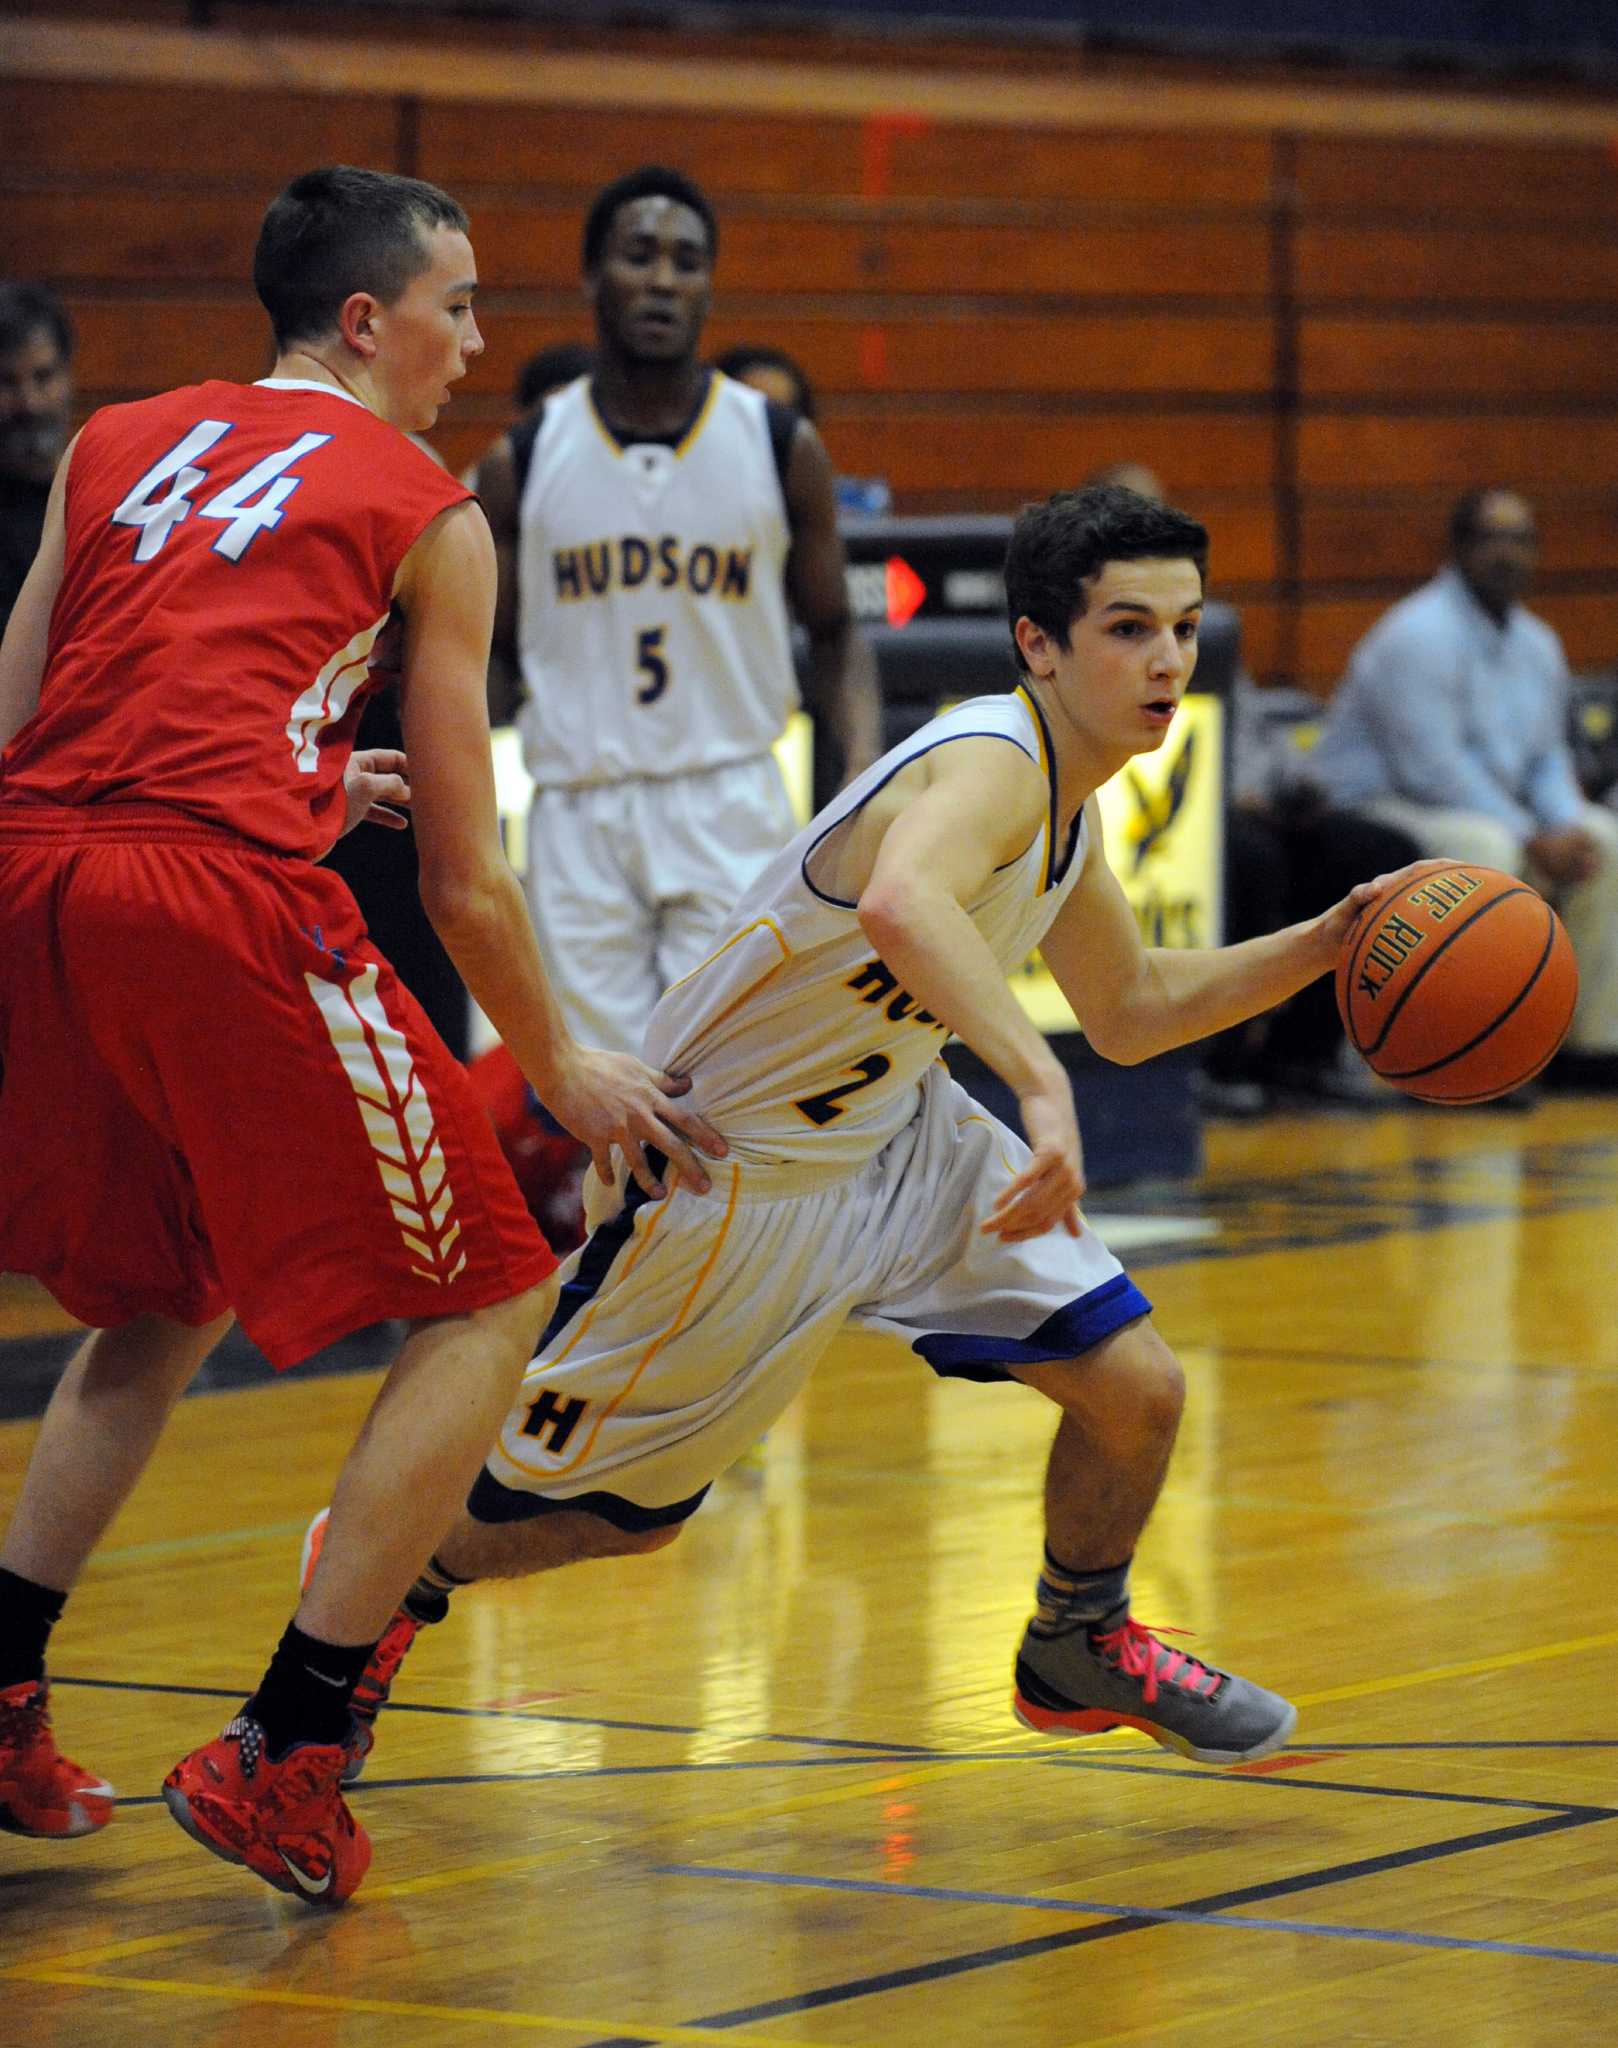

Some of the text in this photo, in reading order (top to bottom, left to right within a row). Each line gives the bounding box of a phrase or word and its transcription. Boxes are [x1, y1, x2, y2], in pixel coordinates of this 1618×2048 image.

[111, 419, 336, 565] 44
[552, 536, 755, 602] HUDSON
[636, 624, 668, 706] 5
[1358, 873, 1484, 1001] THE ROCK
[790, 1052, 894, 1129] 2
[516, 1387, 591, 1457] H
